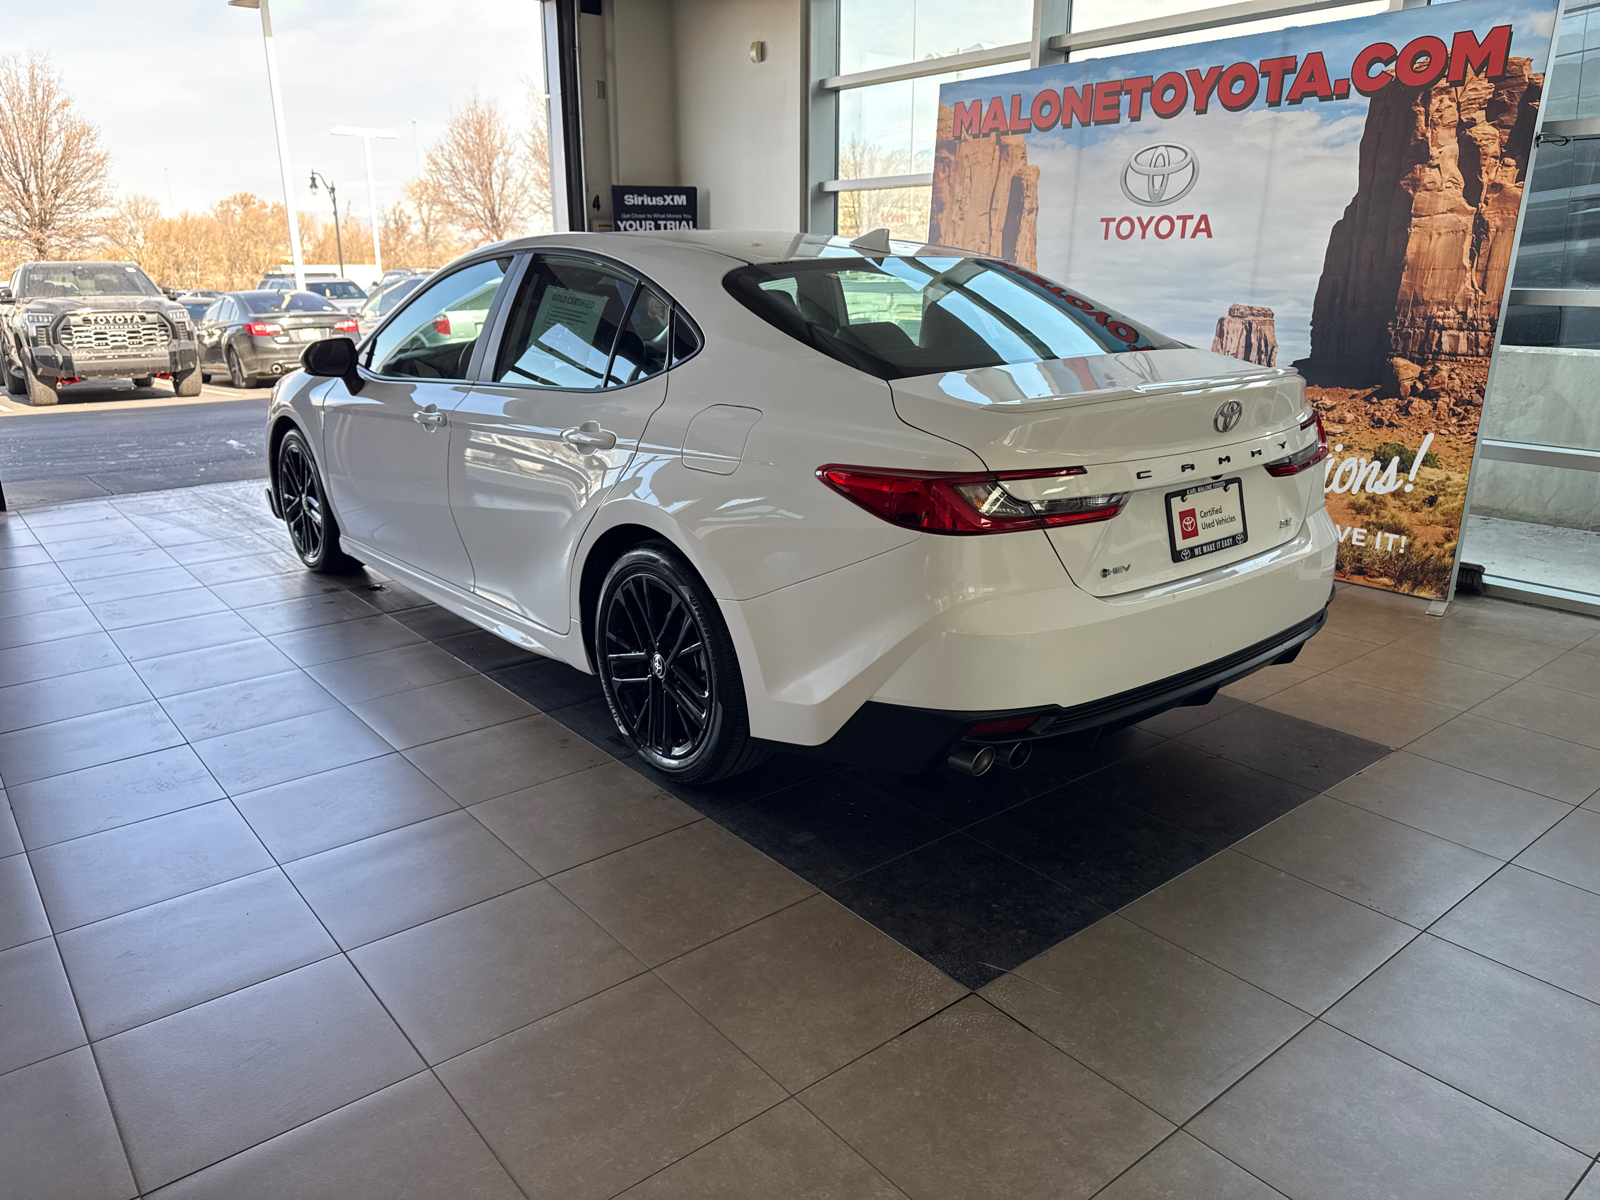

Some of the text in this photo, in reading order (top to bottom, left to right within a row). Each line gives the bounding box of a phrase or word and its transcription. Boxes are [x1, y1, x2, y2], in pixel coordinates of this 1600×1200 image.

[952, 24, 1514, 140] MALONETOYOTA.COM
[592, 194, 601, 212] 4
[624, 194, 687, 206] SiriusXM
[617, 220, 655, 231] YOUR
[658, 220, 697, 231] TRIAL
[1100, 214, 1213, 241] TOYOTA
[551, 293, 596, 309] GOLD CERTIFIED
[88, 315, 141, 325] TOYOTA
[1136, 440, 1287, 480] CAMRY
[1324, 433, 1435, 495] ions!
[1200, 505, 1223, 518] Certified
[1201, 514, 1237, 530] Used Vehicles
[1194, 546, 1202, 556] WE
[1202, 542, 1216, 553] MAKE
[1221, 537, 1234, 548] EASY
[1335, 524, 1407, 554] VE IT!
